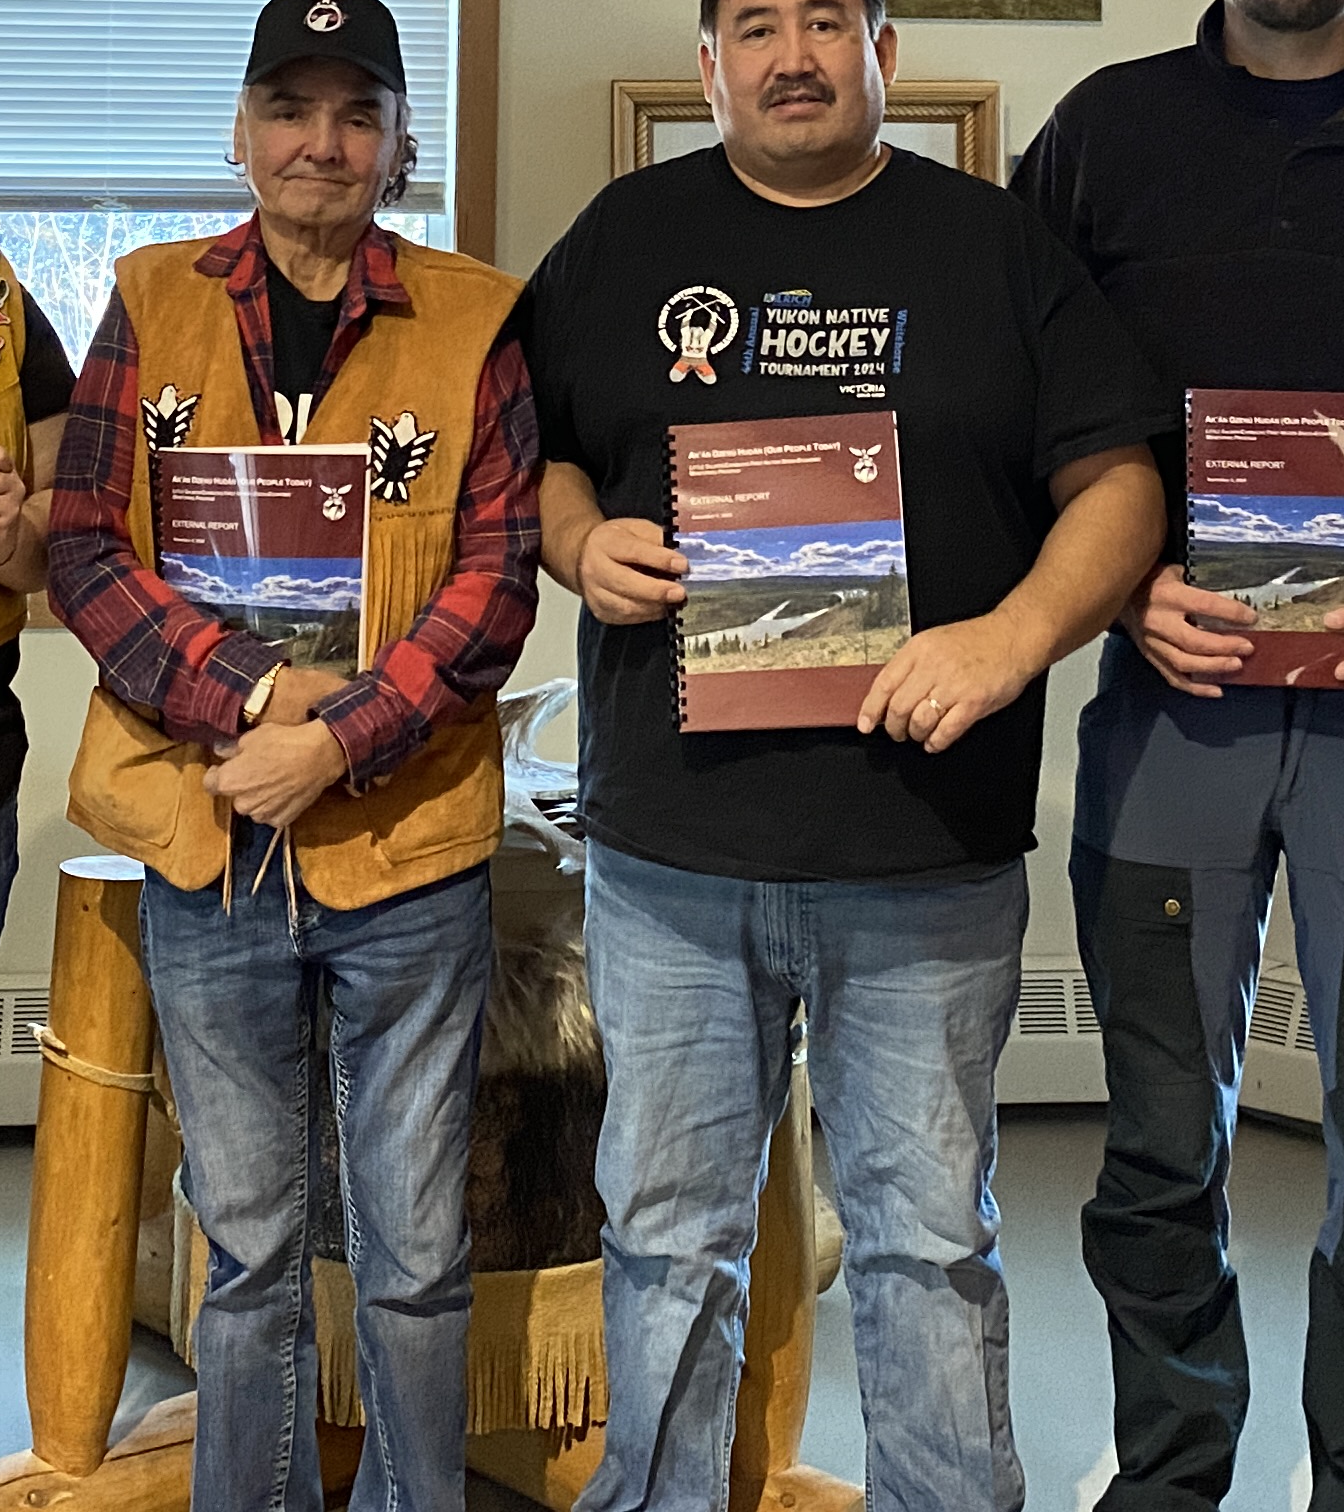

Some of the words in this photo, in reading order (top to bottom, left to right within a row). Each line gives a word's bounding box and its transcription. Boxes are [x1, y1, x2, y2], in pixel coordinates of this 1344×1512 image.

[766, 308, 820, 324] YUKON
[825, 307, 890, 324] NATIVE
[760, 328, 891, 358] HOCKEY
[759, 362, 849, 376] TOURNAMENT
[853, 362, 885, 375] 2024
[1206, 460, 1249, 469] EXTERNAL
[1250, 460, 1285, 469] REPORT
[690, 495, 733, 505] EXTERNAL
[734, 491, 770, 502] REPORT
[208, 521, 239, 530] REPORT
